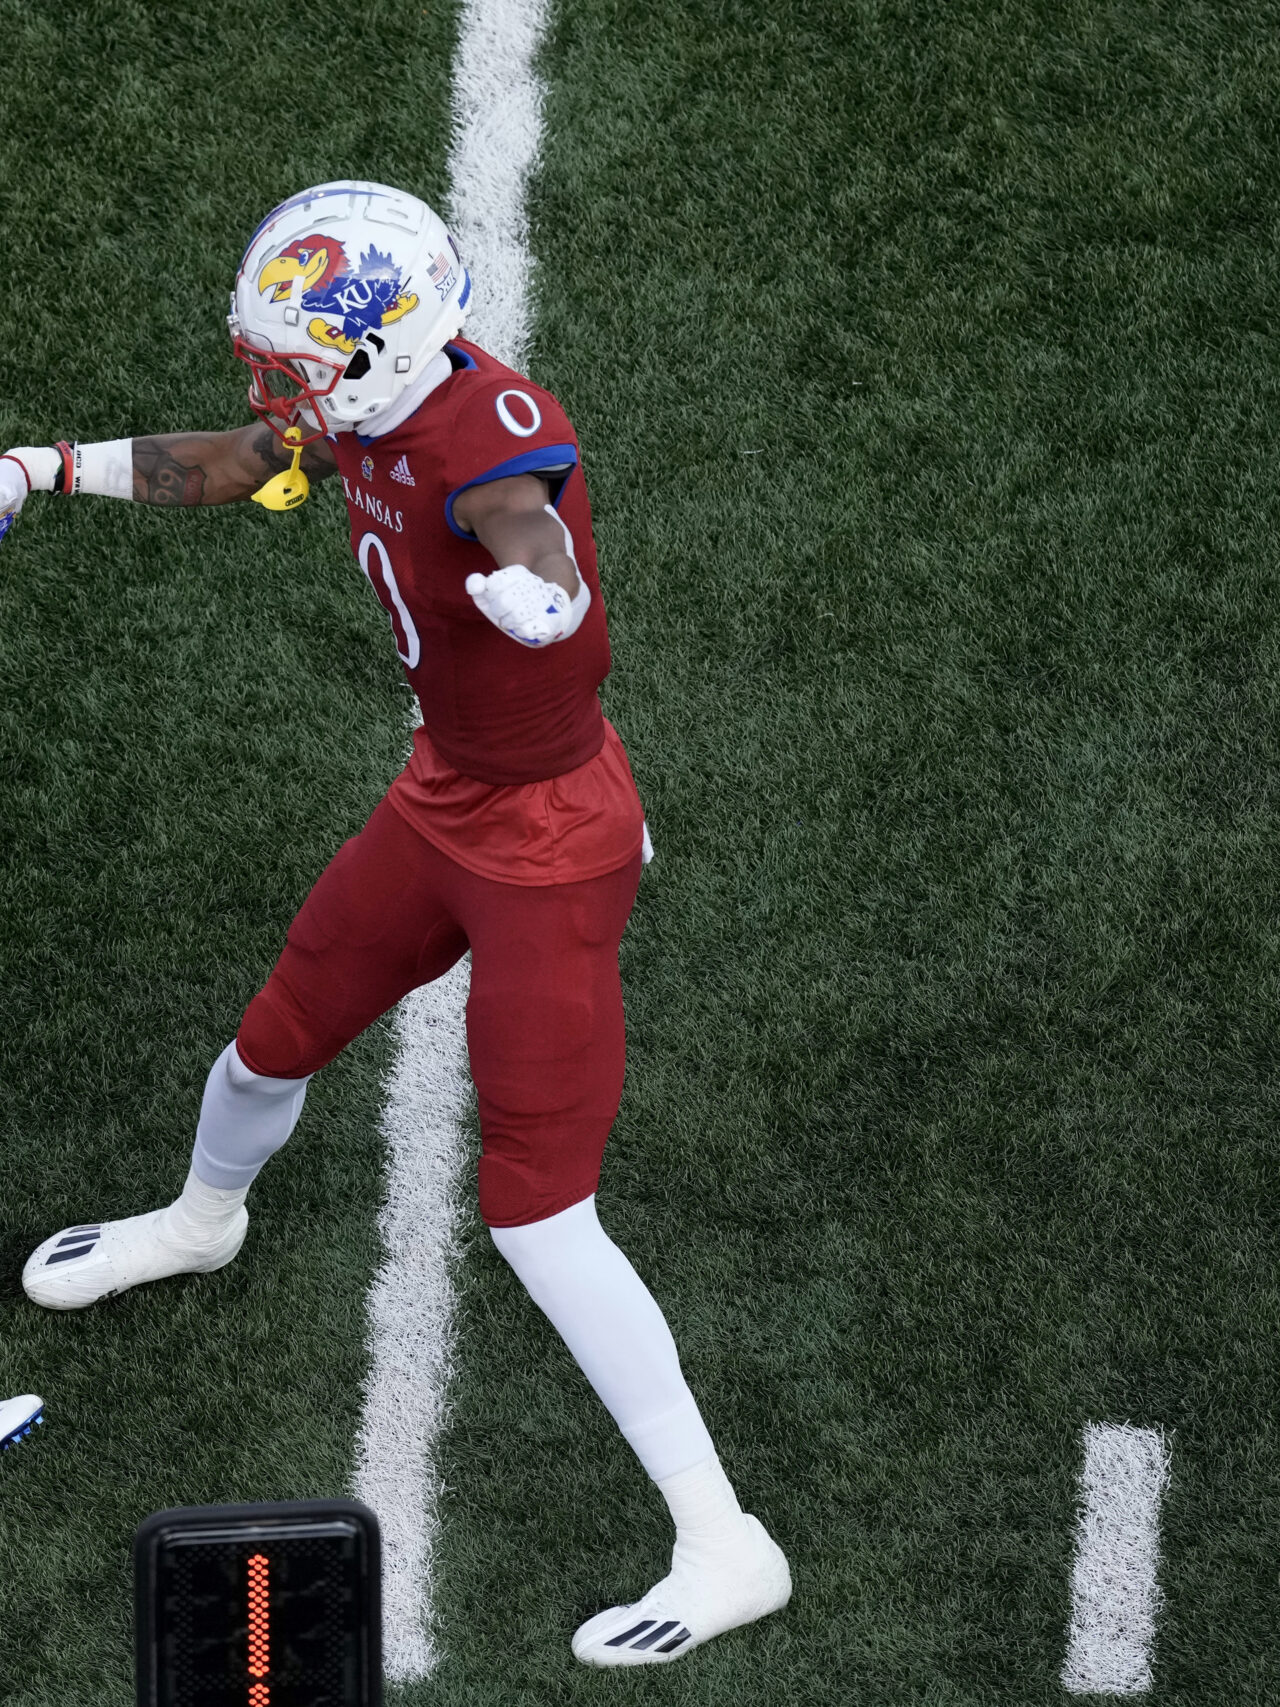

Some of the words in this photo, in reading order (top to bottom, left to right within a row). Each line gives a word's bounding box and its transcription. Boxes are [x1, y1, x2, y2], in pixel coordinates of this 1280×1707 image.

[333, 278, 374, 314] KU
[495, 389, 542, 438] 0
[389, 470, 416, 487] adidas
[342, 476, 404, 533] KANSAS
[358, 531, 421, 670] 0
